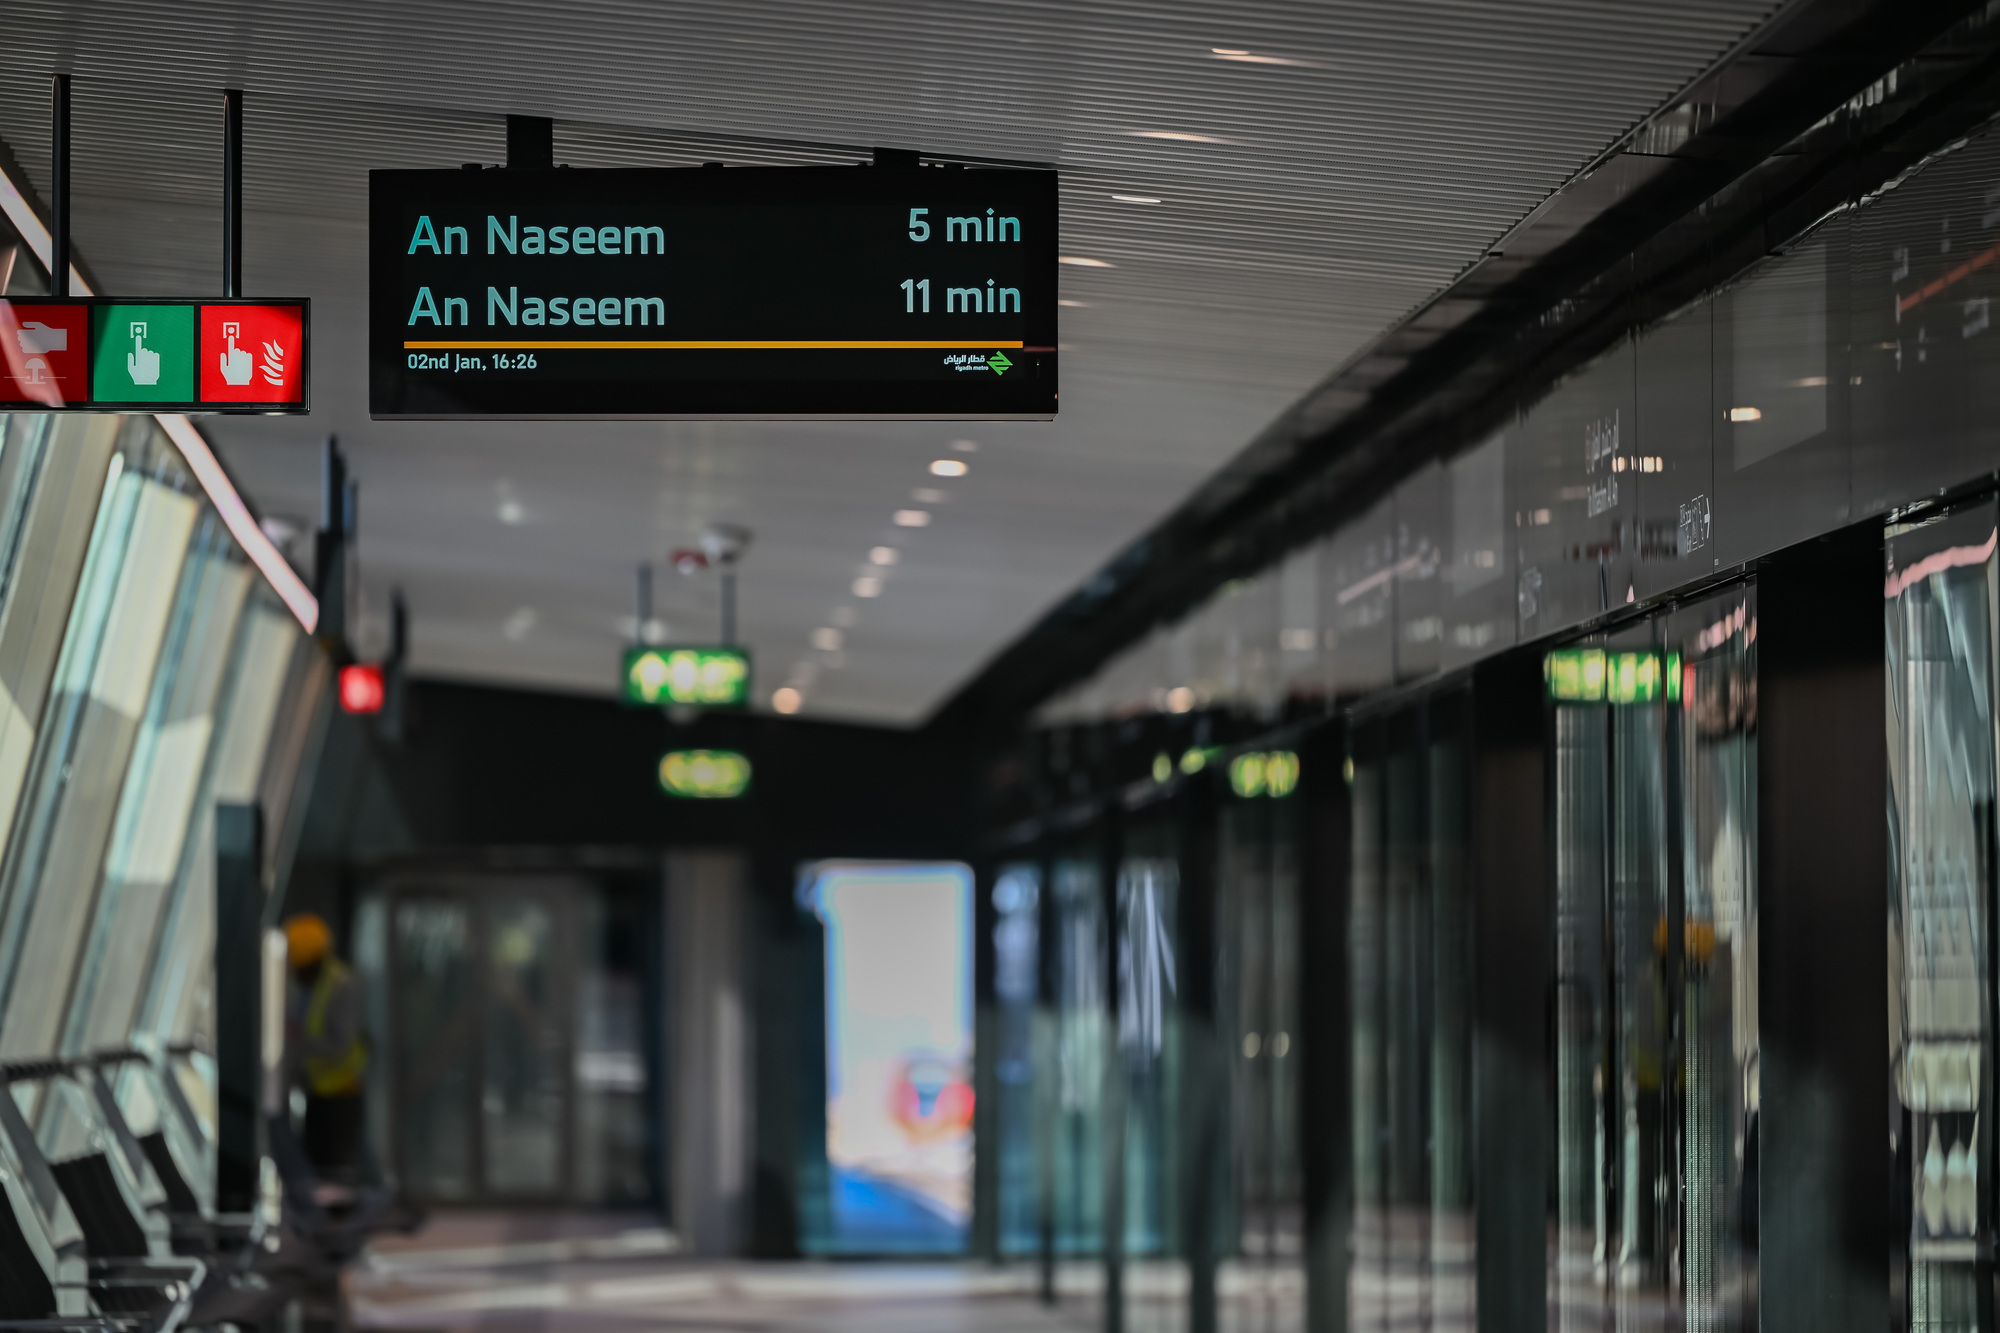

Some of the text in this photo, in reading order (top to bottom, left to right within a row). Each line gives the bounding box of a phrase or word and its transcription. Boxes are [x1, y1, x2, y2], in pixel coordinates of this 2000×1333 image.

[408, 215, 664, 254] An Naseem
[909, 207, 1020, 242] 5 min
[408, 286, 664, 325] An Naseem
[899, 278, 1020, 312] 11 min
[407, 353, 537, 373] 02nd Jan, 16:26
[943, 354, 985, 365] قطار الرياض
